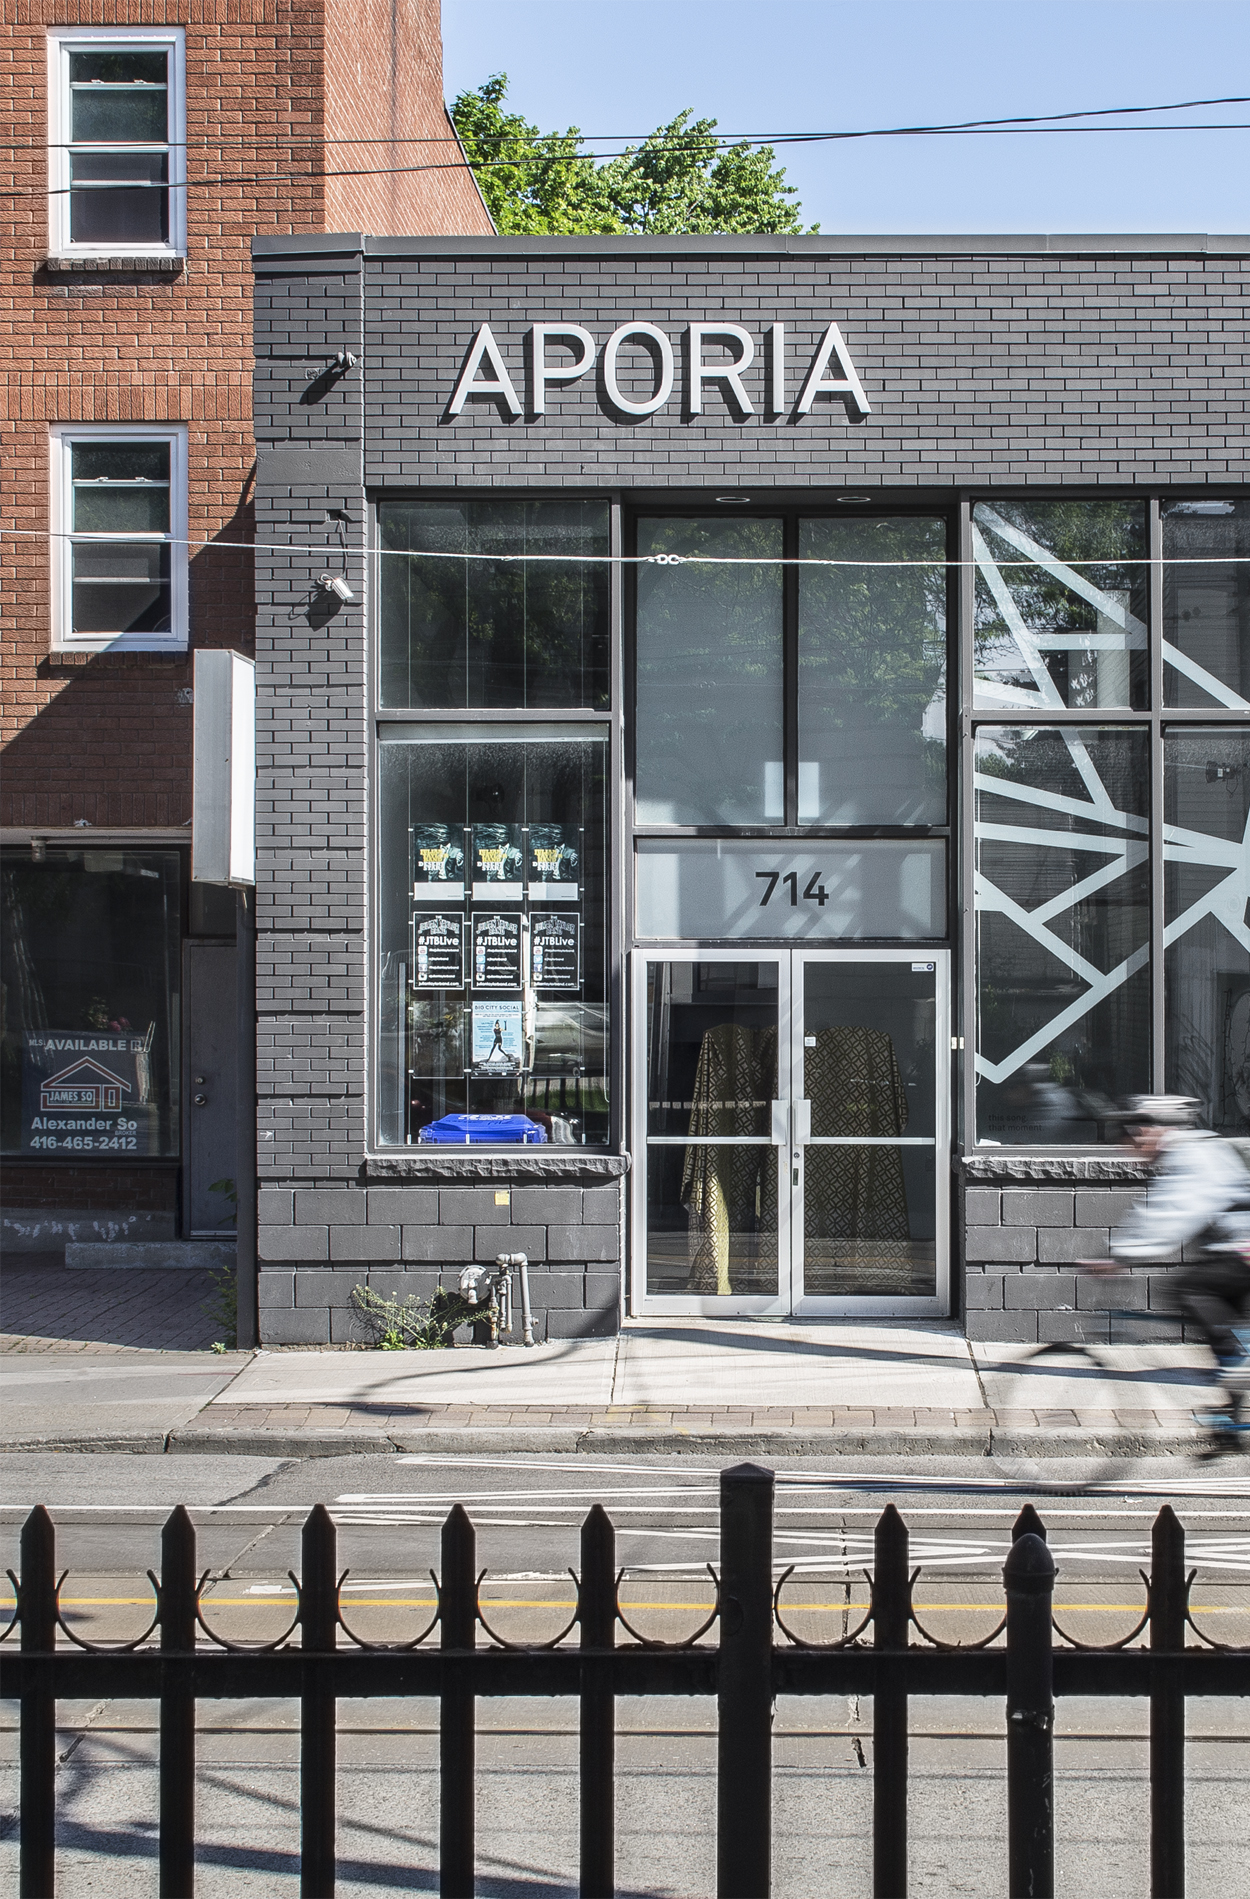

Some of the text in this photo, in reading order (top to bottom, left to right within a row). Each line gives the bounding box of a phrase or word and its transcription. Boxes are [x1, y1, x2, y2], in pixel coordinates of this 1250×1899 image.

[448, 320, 872, 415] APORIA
[755, 871, 830, 907] 714
[418, 935, 460, 946] #JTBLive
[476, 936, 518, 946] #JTBLive
[533, 936, 575, 946] #JTBLive
[44, 1039, 127, 1051] AVAILABLE
[50, 1091, 93, 1101] JAMES SO
[31, 1117, 138, 1130] Alexander So
[988, 1114, 1004, 1122] this
[30, 1136, 137, 1149] 416-465-2412
